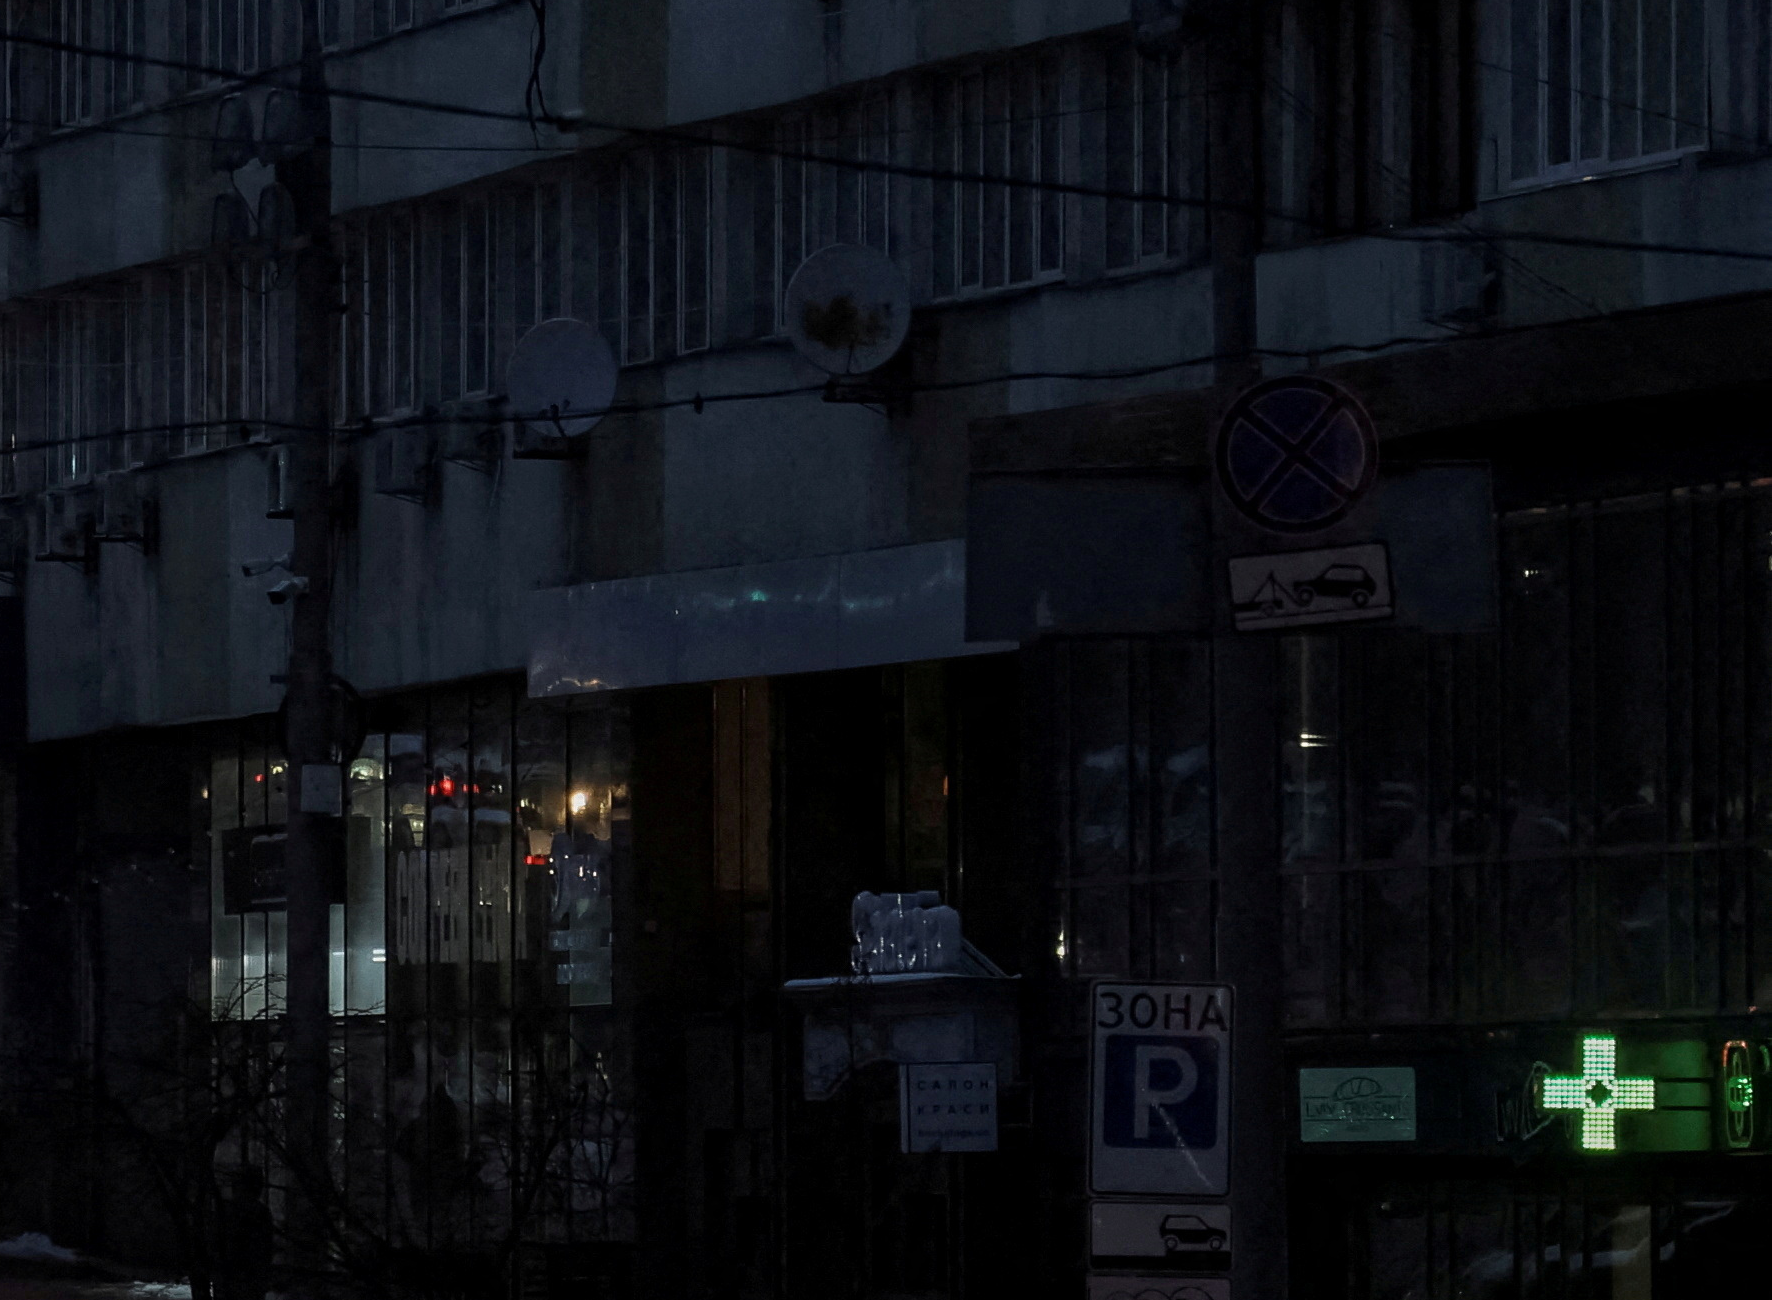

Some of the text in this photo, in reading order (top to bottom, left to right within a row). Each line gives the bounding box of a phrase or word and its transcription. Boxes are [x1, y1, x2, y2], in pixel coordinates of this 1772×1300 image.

[1098, 992, 1228, 1033] ЗОНА
[917, 1080, 989, 1090] САЛОН
[1134, 1045, 1199, 1140] P
[918, 1104, 989, 1115] КРАСИ
